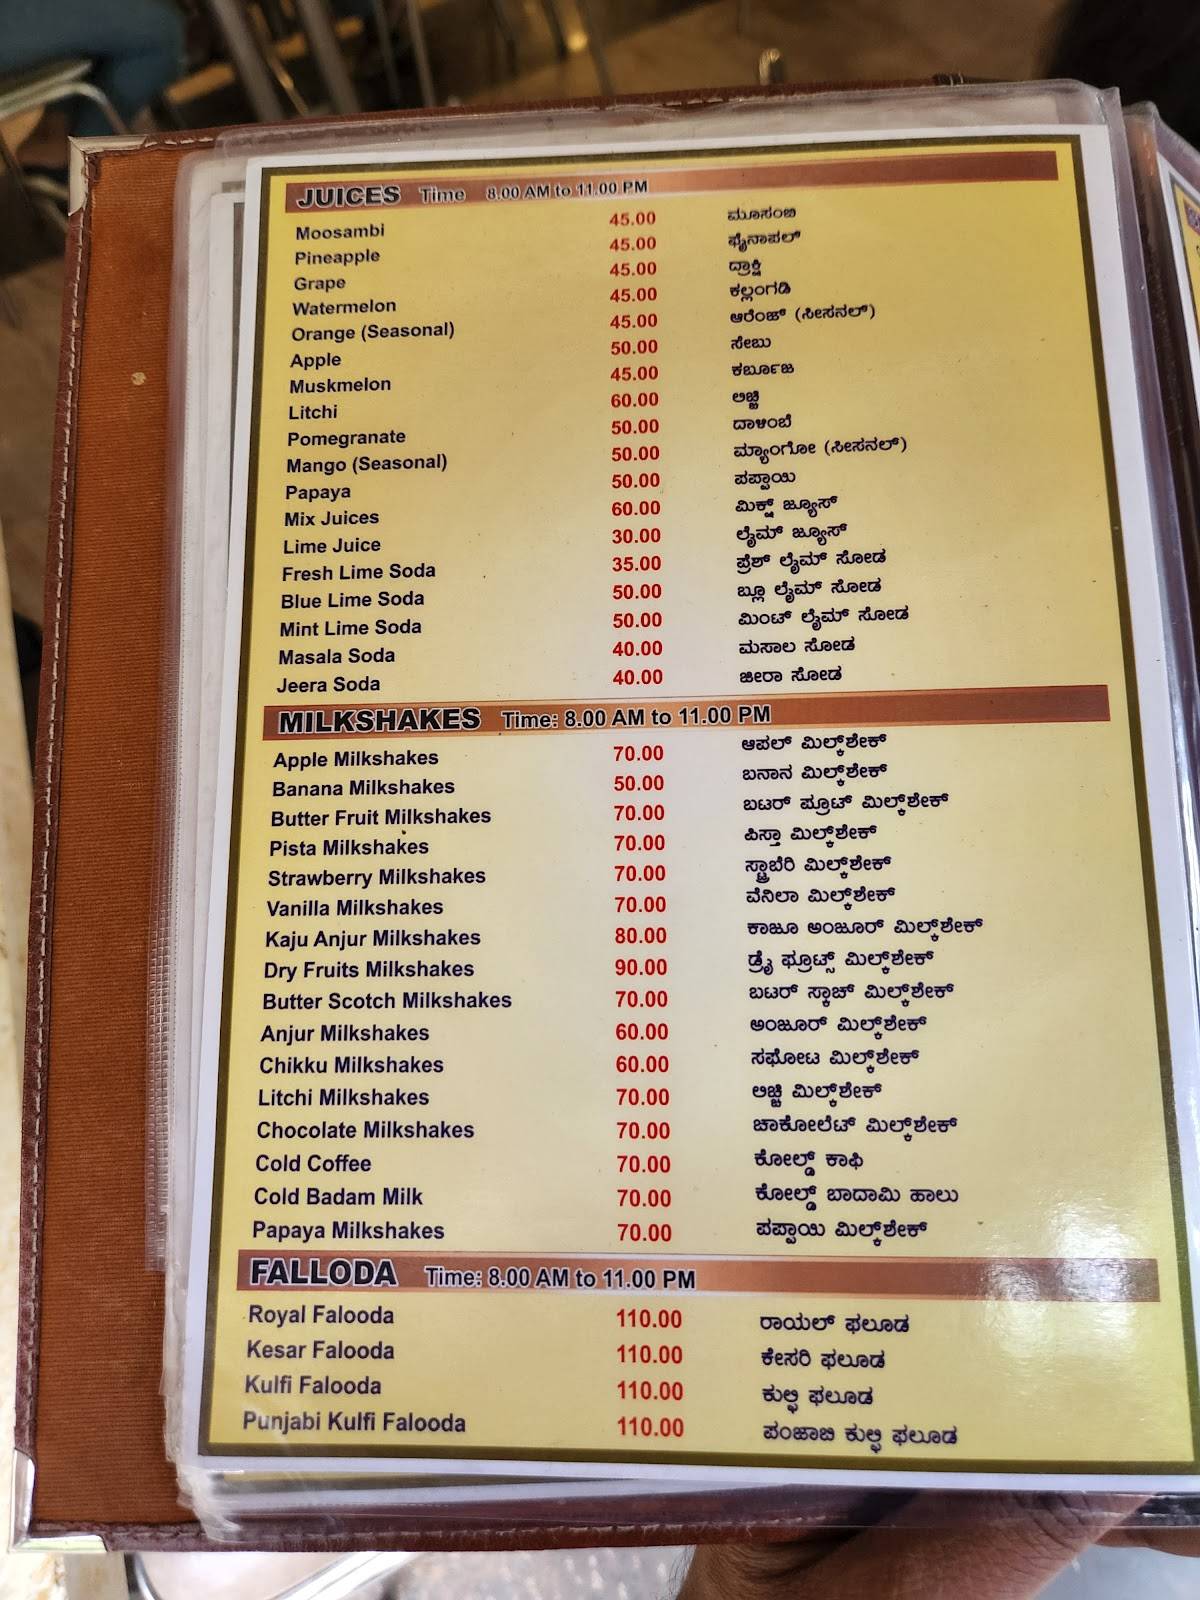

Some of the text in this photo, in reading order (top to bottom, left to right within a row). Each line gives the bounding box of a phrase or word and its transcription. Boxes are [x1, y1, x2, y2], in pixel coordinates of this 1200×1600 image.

[297, 180, 648, 208] JUICES Time 8.00 AM to 11.00 PM
[609, 210, 657, 227] 45.00
[294, 222, 386, 242] Moosambi
[609, 235, 657, 252] 45.00
[294, 248, 381, 268] Pineapple
[609, 261, 657, 277] 45.00
[293, 276, 347, 294] Grape
[609, 286, 658, 304] 45.00
[291, 298, 397, 317] Watermelon
[609, 312, 658, 330] 45.00
[291, 320, 455, 344] Orange (Seasonal)
[731, 333, 772, 350] ಸೇಬು
[610, 338, 659, 356] 50.00
[289, 351, 342, 371] Apple
[610, 365, 659, 382] 45.00
[289, 376, 392, 395] Muskmelon
[610, 391, 659, 409] 60.00
[288, 403, 338, 421] Litchi
[611, 418, 660, 436] 50.00
[287, 429, 407, 449] Pomegranate
[611, 445, 660, 463] 50.00
[286, 452, 448, 476] Mango (Seasonal)
[611, 472, 661, 490] 50.00
[285, 484, 352, 503] Papaya
[611, 499, 661, 517] 60.00
[284, 509, 380, 527] Mix Juices
[611, 527, 662, 545] 30.00
[283, 537, 382, 555] Lime Juice
[282, 562, 436, 582] Fresh Lime Soda
[611, 555, 662, 573] 35.00
[281, 589, 425, 610] Blue Lime Soda
[612, 583, 662, 601] 50.00
[279, 618, 422, 638] Mint Lime Soda
[612, 611, 663, 629] 50.00
[612, 639, 663, 657] 40.00
[739, 636, 856, 655] ಮಸಾಲ ಸೋಡ
[278, 646, 396, 666] Masala Soda
[276, 675, 381, 694] Jeera Soda
[612, 668, 664, 686] 40.00
[279, 705, 770, 733] MILKSHAKES Time: 8.00 AM to 11.00 PM
[272, 749, 440, 772] Apple Milkshakes
[613, 744, 665, 762] 70.00
[272, 778, 456, 798] Banana Milkshakes
[613, 774, 665, 792] 50.00
[271, 807, 492, 828] Butter Fruit Milkshakes
[613, 803, 665, 822] 70.00
[269, 838, 430, 857] Pista Milkshakes
[613, 833, 666, 852] 70.00
[267, 867, 487, 890] Strawberry Milkshakes
[613, 864, 667, 882] 70.00
[266, 898, 444, 918] Vanilla Milkshakes
[614, 895, 667, 914] 70.00
[265, 928, 482, 953] Kaju Anjur Milkshakes
[614, 926, 668, 945] 80.00
[263, 959, 475, 984] Dry Fruits Milkshakes
[614, 958, 668, 977] 90.00
[262, 990, 513, 1011] Butter Scotch Milkshakes
[615, 989, 669, 1009] 70.00
[259, 1023, 430, 1047] Anjur Milkshakes
[615, 1022, 669, 1041] 60.00
[259, 1055, 445, 1075] Chikku Milkshakes
[615, 1055, 670, 1074] 60.00
[258, 1087, 430, 1107] Litchi Milkshakes
[615, 1087, 670, 1106] 70.00
[256, 1120, 475, 1139] Chocolate Milkshakes
[616, 1121, 671, 1140] 70.00
[255, 1153, 372, 1173] Cold Coffee
[616, 1154, 672, 1174] 70.00
[253, 1186, 424, 1206] Cold Badam Milk
[616, 1188, 672, 1208] 70.00
[252, 1219, 445, 1244] Papaya Milkshakes
[617, 1223, 673, 1243] 70.00
[251, 1258, 695, 1290] FALLODA Time: 8.00 AM to 11.00 PM
[248, 1303, 395, 1329] Royal Falooda
[616, 1308, 683, 1329] 110.00
[246, 1339, 395, 1361] Kesar Falooda
[616, 1343, 683, 1365] 110.00
[244, 1374, 382, 1396] Kulfi Falooda
[616, 1379, 684, 1402] 110.00
[242, 1410, 466, 1436] Punjabi Kulfi Falooda
[617, 1415, 685, 1438] 110.00
